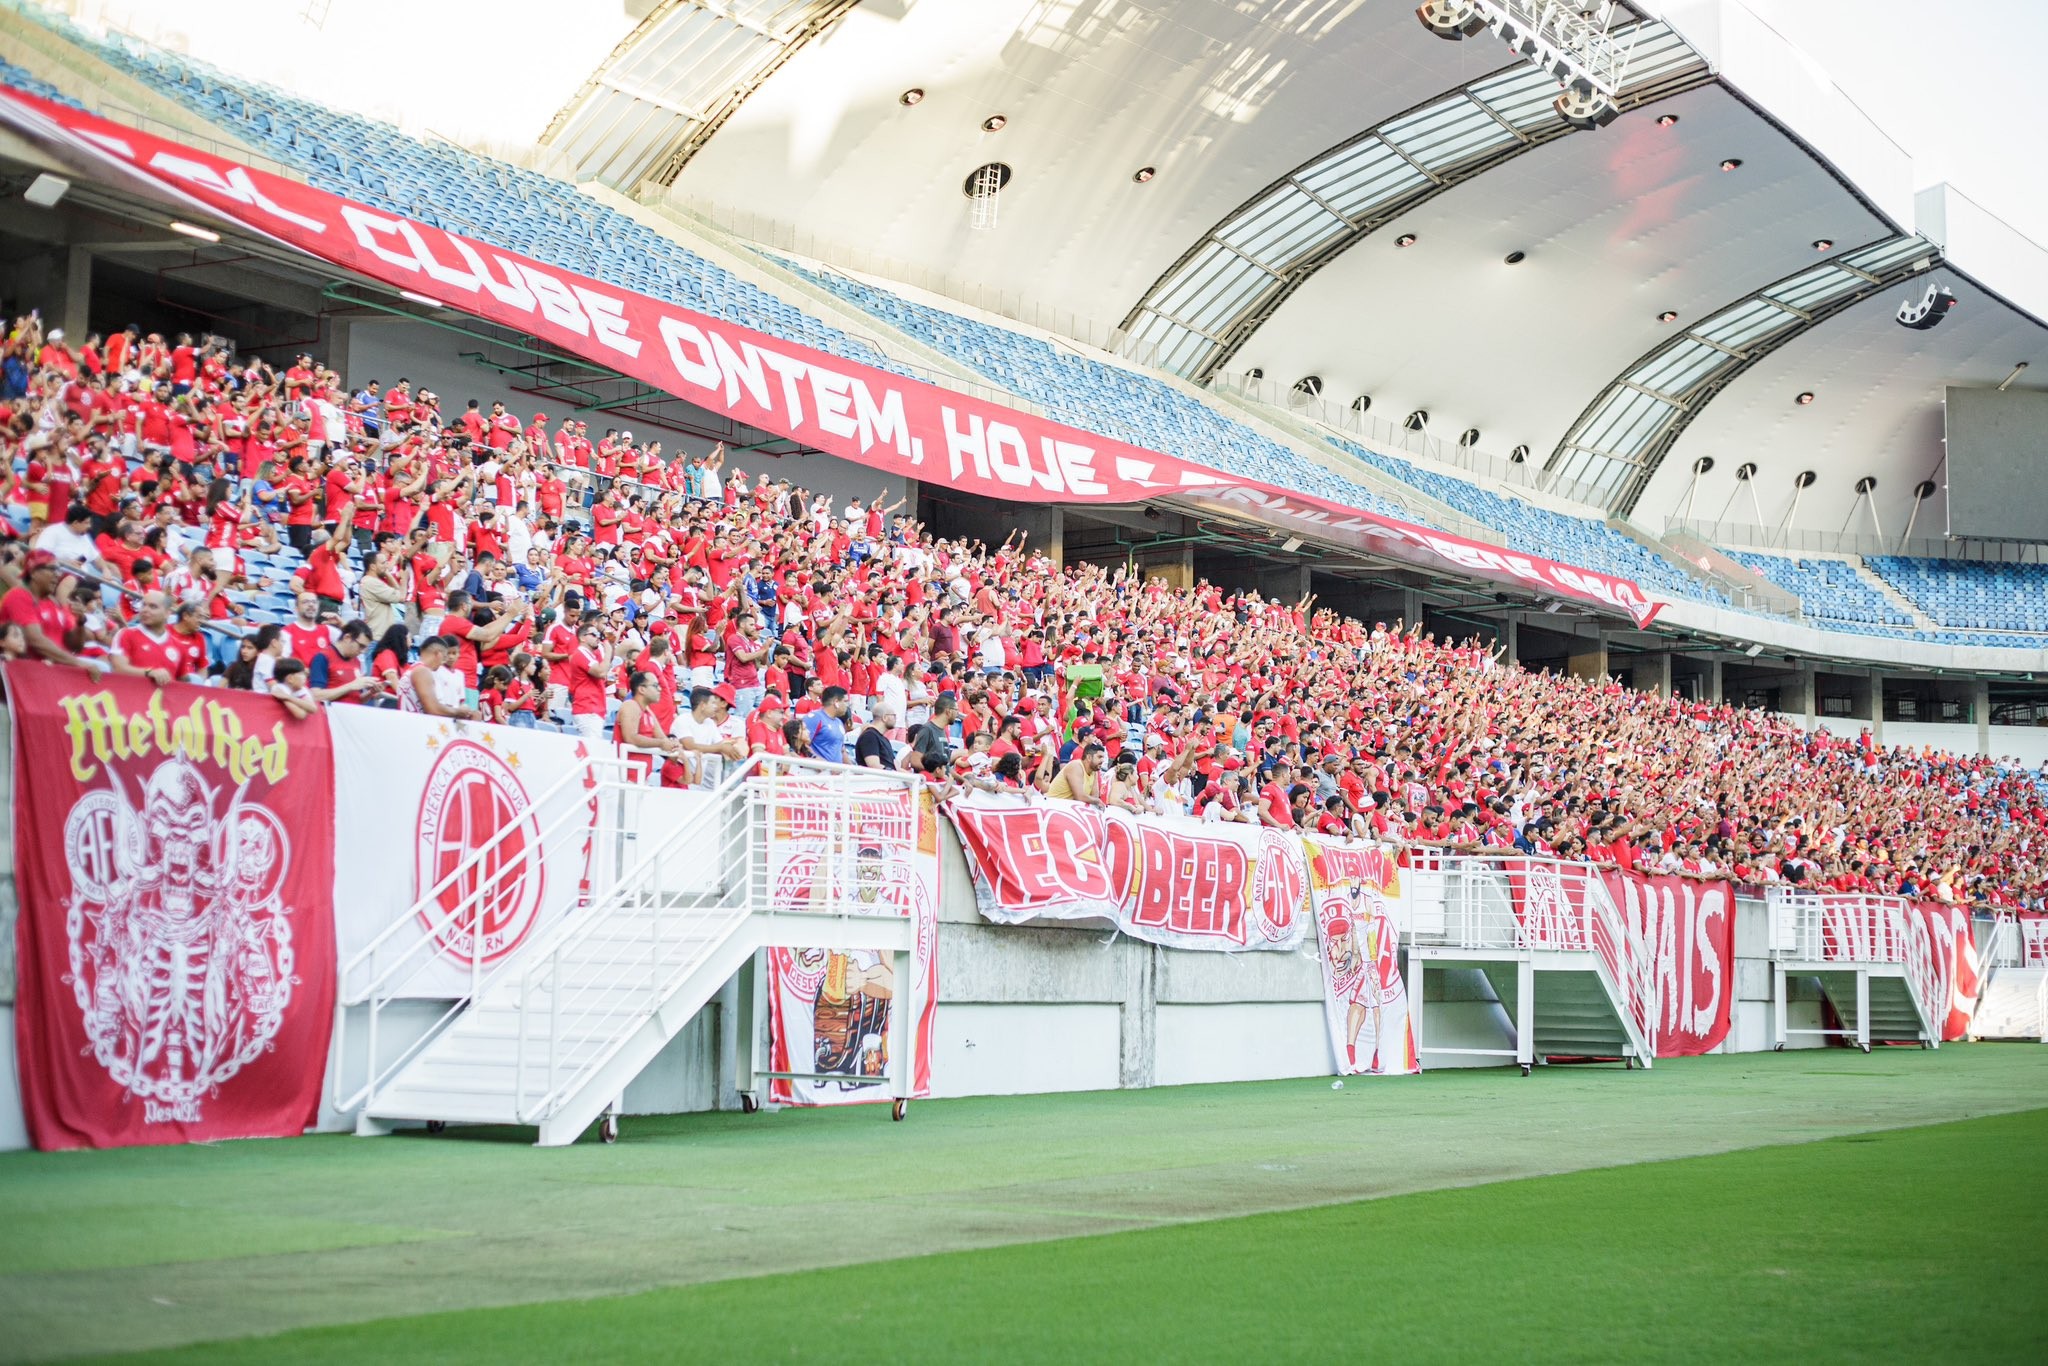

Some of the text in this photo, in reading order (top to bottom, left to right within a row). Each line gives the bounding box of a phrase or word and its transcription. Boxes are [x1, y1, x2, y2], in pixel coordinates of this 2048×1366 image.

[340, 203, 643, 360] CLUBE
[658, 314, 925, 466] ONTEM,
[940, 404, 1110, 497] HOJE
[500, 773, 525, 812] CLUB
[1132, 825, 1246, 945] BEER
[486, 932, 504, 952] RN
